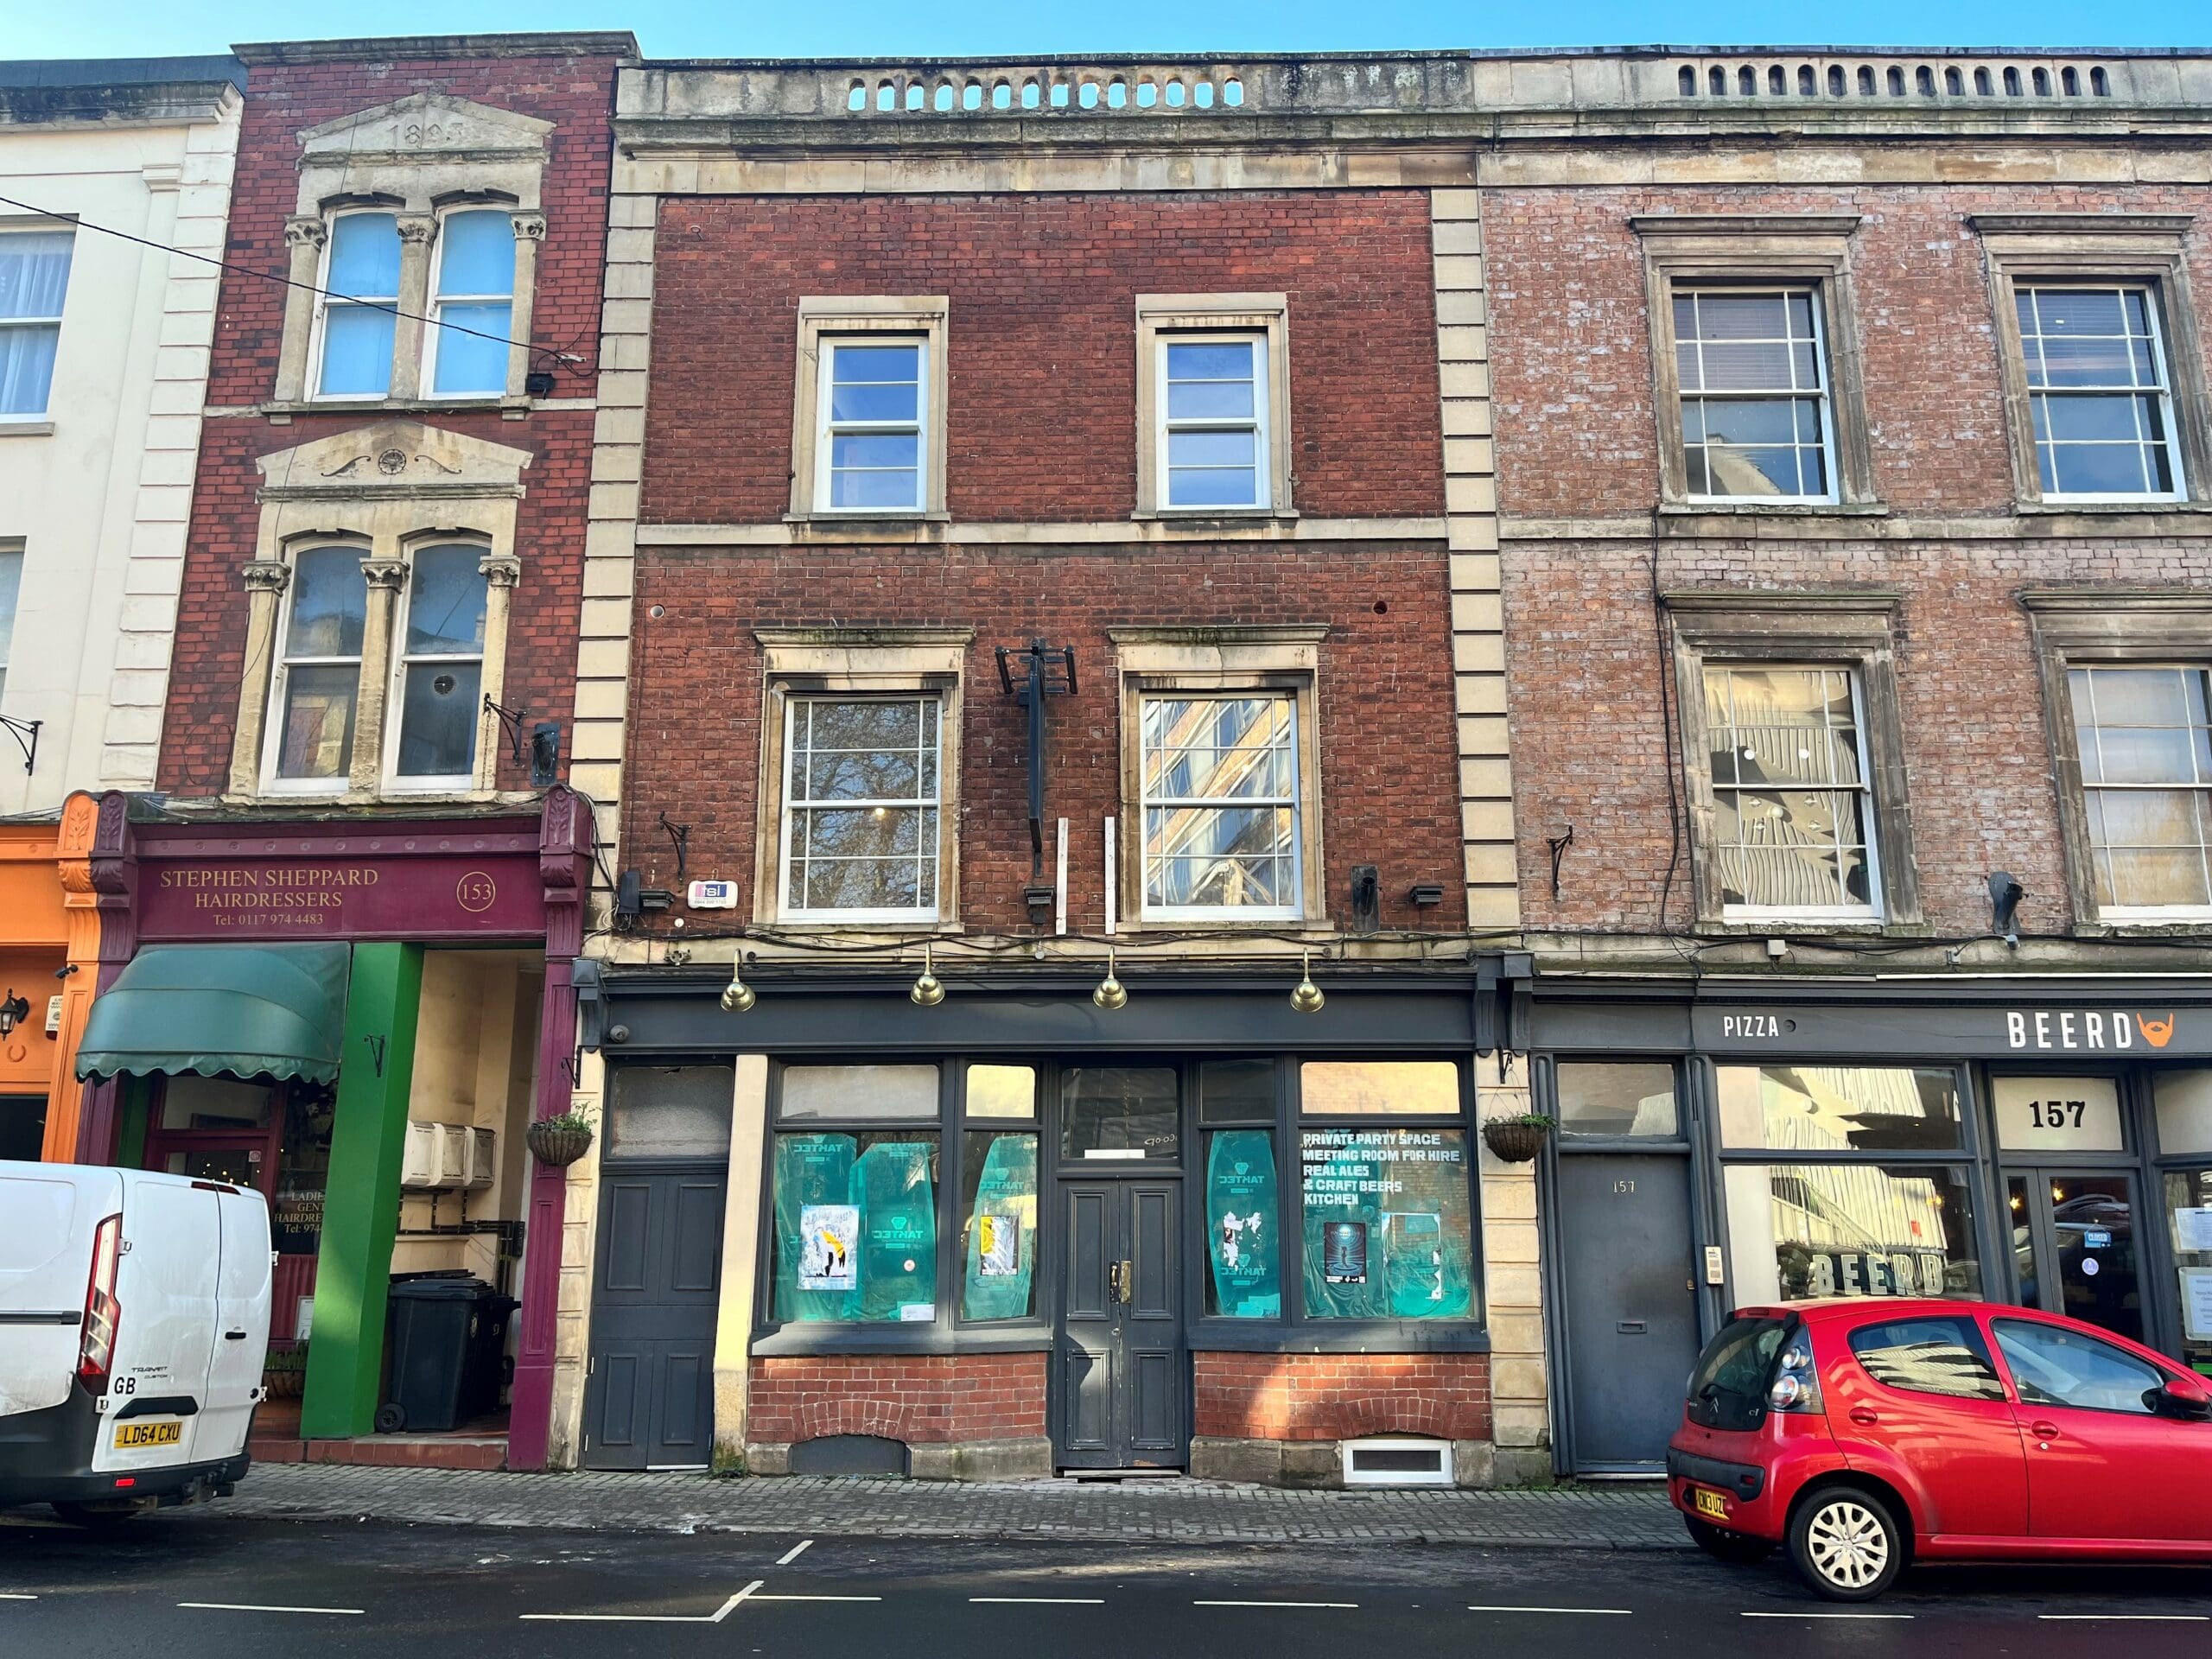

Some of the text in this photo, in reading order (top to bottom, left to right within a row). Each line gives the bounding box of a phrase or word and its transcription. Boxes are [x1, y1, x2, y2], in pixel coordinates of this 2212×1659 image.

[161, 869, 378, 887] STEPHEN SHEPPARD
[463, 884, 491, 900] 153
[195, 892, 342, 908] HAIRDRESSERS
[213, 913, 323, 925] Tel: 0117 974 4483
[1723, 1015, 1779, 1037] PIZZA
[2006, 1011, 2133, 1049] BEERD
[2029, 1100, 2086, 1128] 157
[1302, 1134, 1441, 1146] PRIVATE PARTY SPACE
[1302, 1150, 1460, 1162] MEETING ROOM FOR HIRE
[1303, 1165, 1370, 1177] REAL ALES
[1303, 1179, 1402, 1192] & CRAFT BEERS
[1614, 1180, 1635, 1192] 157
[291, 1192, 325, 1202] LADIE
[1304, 1193, 1359, 1205] KITCHEN
[297, 1203, 325, 1211] GENT
[275, 1213, 323, 1223] HAIRDRE
[303, 1224, 321, 1233] 974
[1812, 1254, 1944, 1295] BEERD
[114, 1376, 136, 1395] GB
[124, 1424, 181, 1444] LD64 CXU
